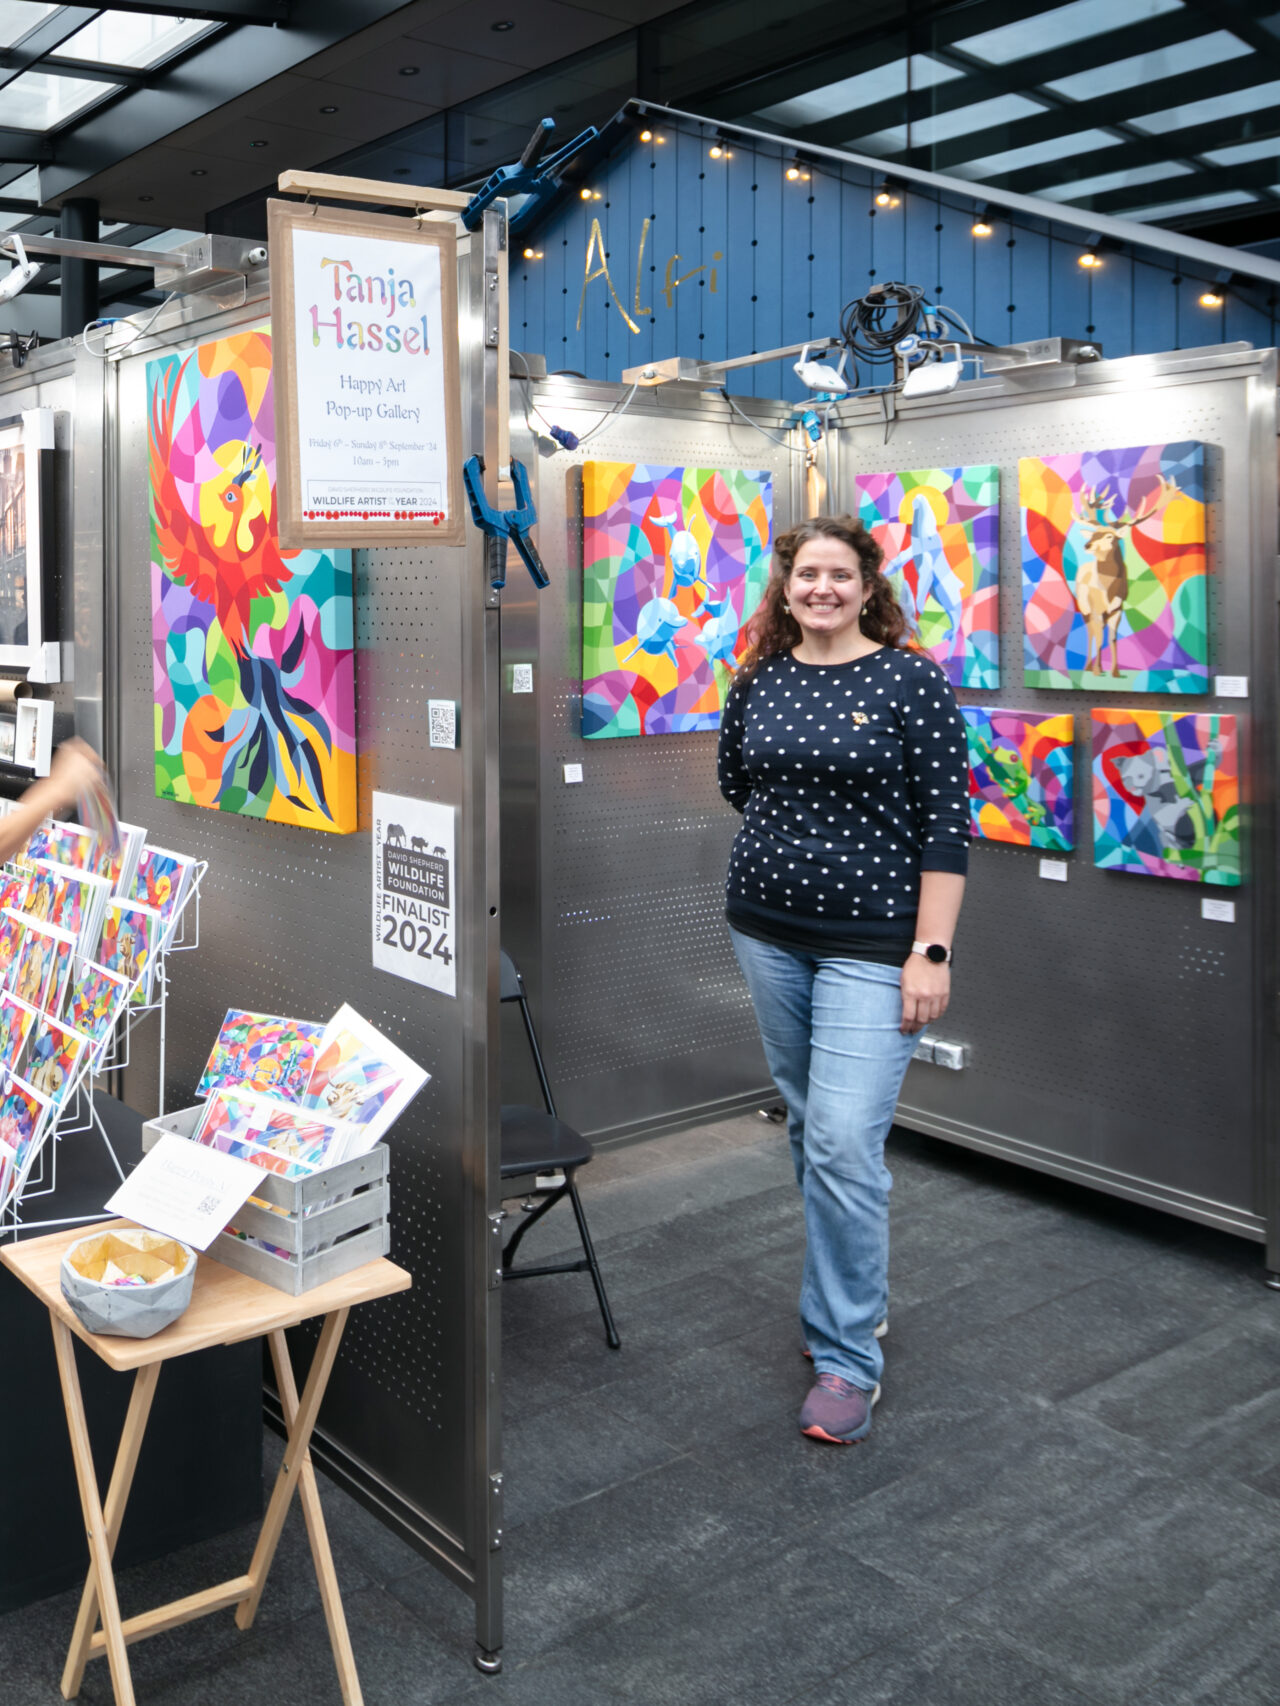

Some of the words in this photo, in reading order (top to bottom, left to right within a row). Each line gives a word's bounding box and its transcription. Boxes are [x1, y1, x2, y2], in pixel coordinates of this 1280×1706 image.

[320, 257, 416, 317] Tanja
[309, 304, 430, 355] Hassel
[340, 374, 382, 395] Happy
[386, 378, 406, 392] Art
[326, 400, 372, 421] Pop-up
[376, 403, 420, 423] Gallery
[309, 438, 331, 450] Friday
[351, 440, 377, 451] Sunday
[389, 441, 425, 452] September
[353, 456, 374, 465] 10am
[312, 496, 355, 506] WILDLIFE
[358, 497, 387, 506] ARTIST
[395, 497, 418, 506] YEAR
[387, 850, 408, 862] DAVID
[409, 856, 444, 872] SHEPHERD
[388, 861, 444, 889] WILDLIFE
[387, 876, 445, 902] FOUNDATION
[382, 893, 450, 929] FINALIST
[382, 914, 453, 966] 2024
